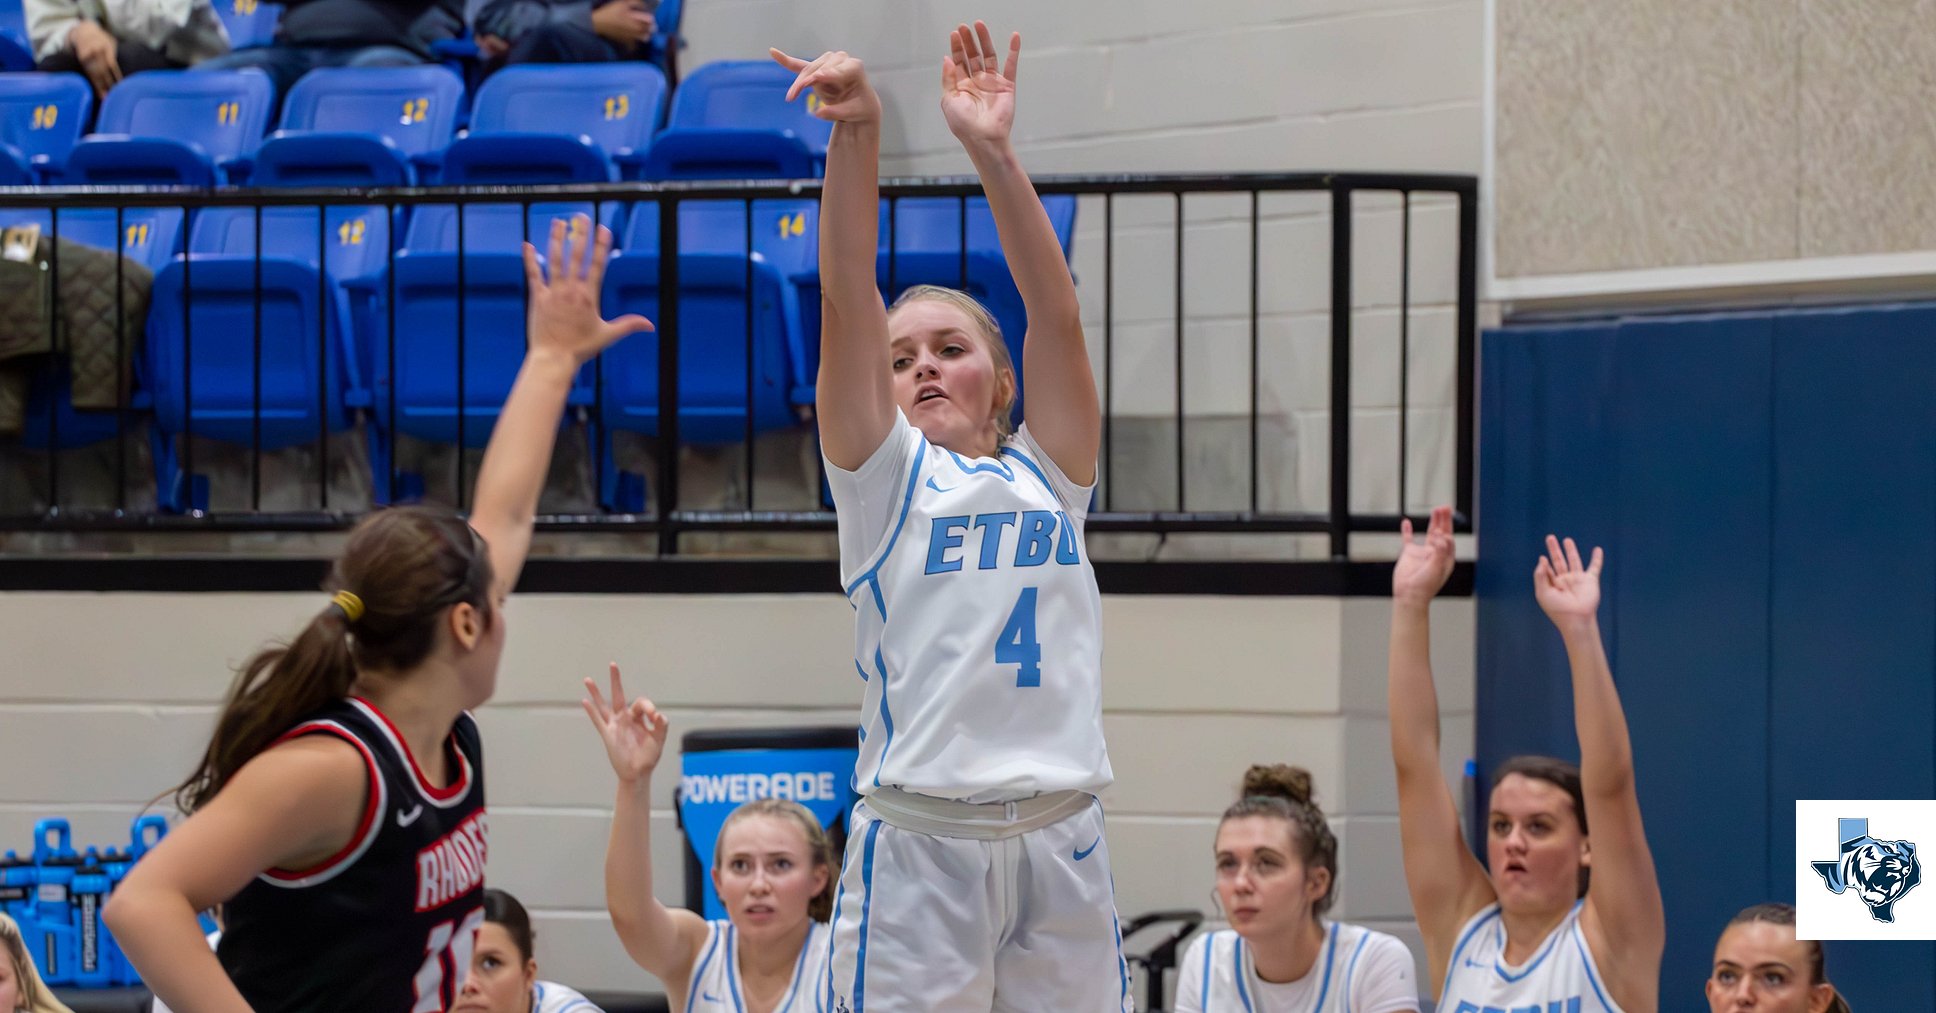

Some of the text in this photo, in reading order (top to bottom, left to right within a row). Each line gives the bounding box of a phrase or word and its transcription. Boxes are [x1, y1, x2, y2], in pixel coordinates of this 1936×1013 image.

[33, 104, 58, 129] 10
[217, 101, 239, 125] 11
[401, 97, 428, 124] 12
[604, 94, 629, 121] 13
[126, 223, 148, 248] 11
[338, 221, 365, 245] 12
[779, 212, 805, 239] 14
[924, 510, 1080, 575] ETBU
[994, 586, 1042, 688] 4
[682, 772, 836, 804] POWERADE
